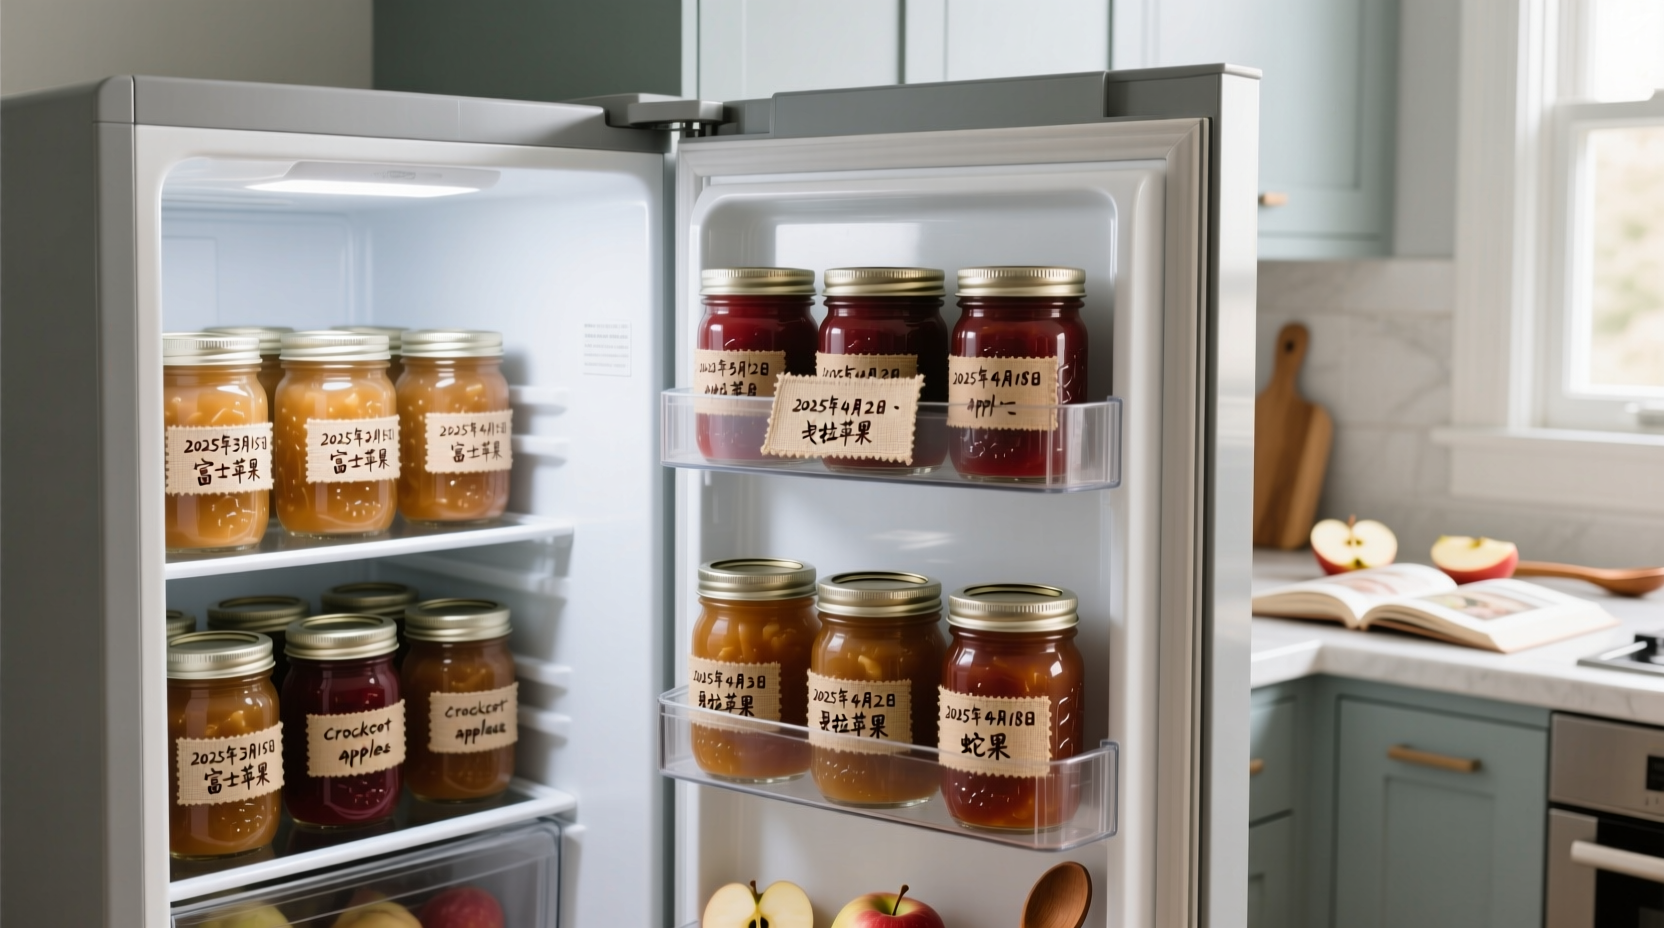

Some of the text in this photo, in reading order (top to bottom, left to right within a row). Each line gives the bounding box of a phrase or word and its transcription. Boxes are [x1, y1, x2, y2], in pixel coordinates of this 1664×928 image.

[330, 449, 390, 474] 富士苹果
[451, 441, 503, 462] 富士苹果
[194, 458, 261, 486] 富士苹果
[813, 687, 896, 709] 2025年4月2日
[945, 704, 1035, 727] 2025年4月18日
[191, 739, 275, 766] 2025年3月15日
[960, 732, 1011, 761] 蛇果
[204, 762, 270, 795] 富士苹果
